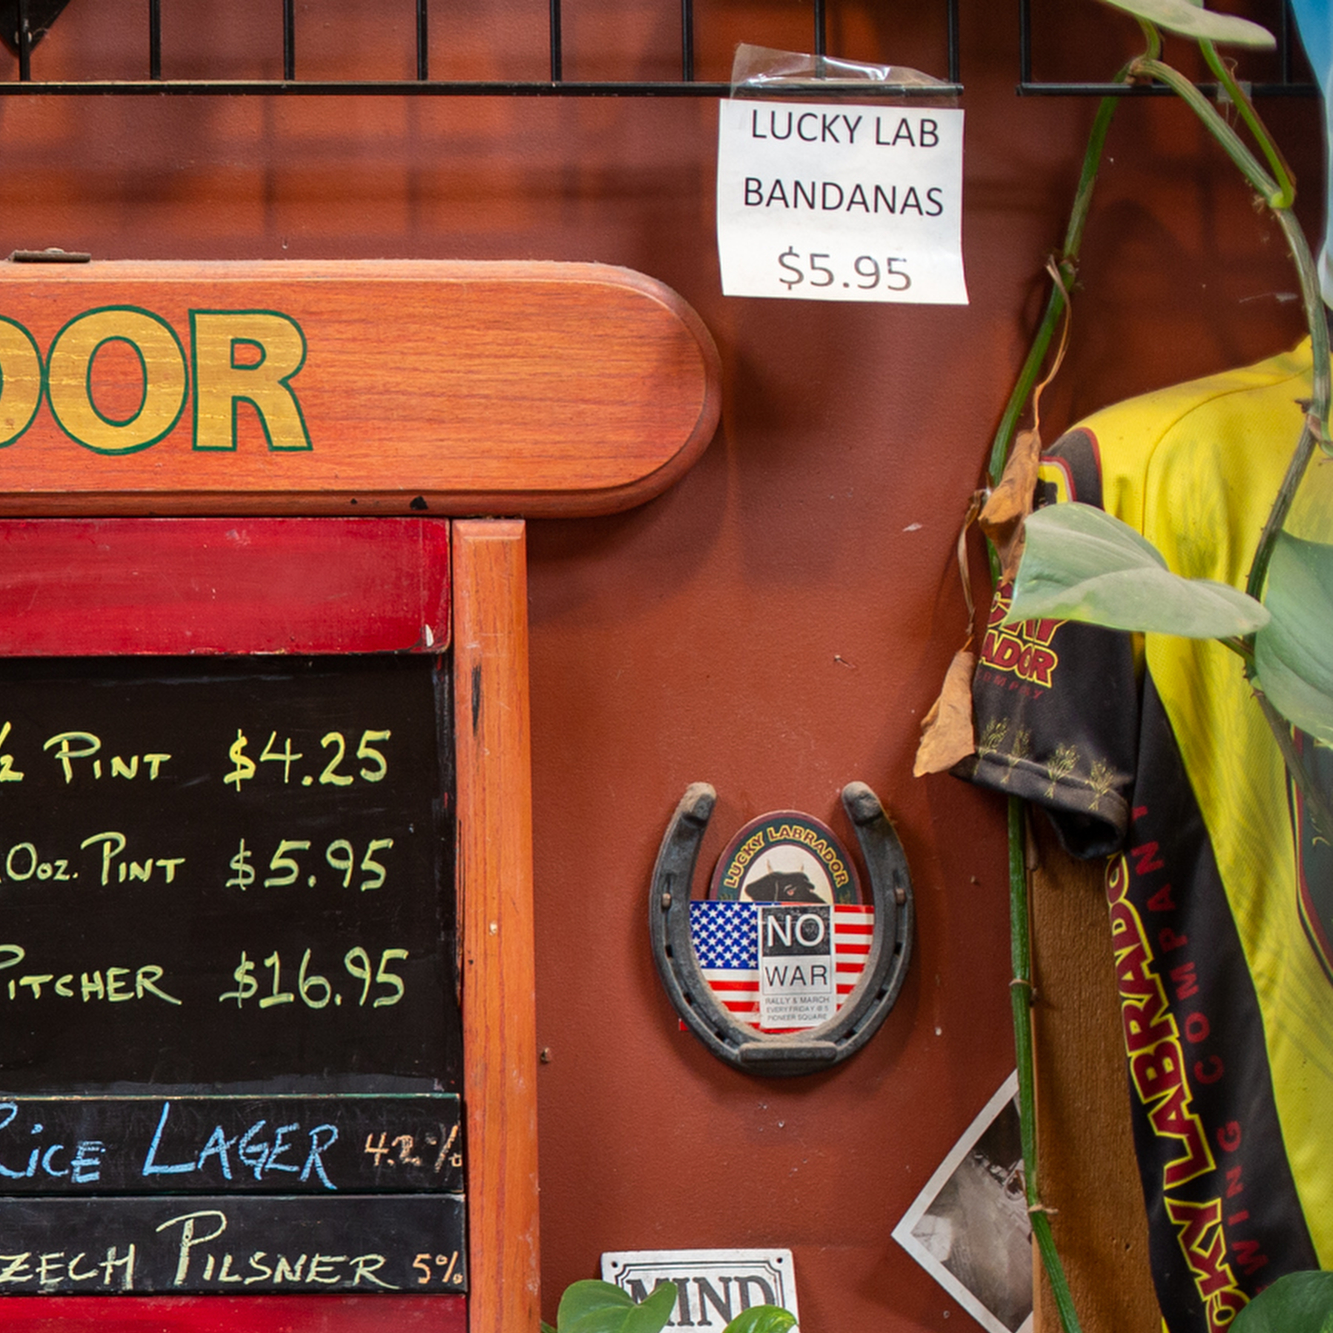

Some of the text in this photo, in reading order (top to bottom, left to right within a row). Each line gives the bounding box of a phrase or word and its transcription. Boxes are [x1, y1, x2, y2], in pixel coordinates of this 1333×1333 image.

[751, 109, 941, 148] LUCKY LAB
[743, 176, 945, 217] BANDANAS
[777, 246, 912, 292] $5.95
[223, 727, 392, 792] $4.25
[225, 837, 395, 891] $5.95
[724, 824, 851, 889] LUCKY LABRADOR
[765, 914, 826, 949] NO
[219, 945, 410, 1009] $16.95
[764, 964, 829, 988] WAR
[142, 1101, 339, 1191] LAGER
[155, 1209, 403, 1289] PILSNER
[411, 1250, 464, 1286] 5%
